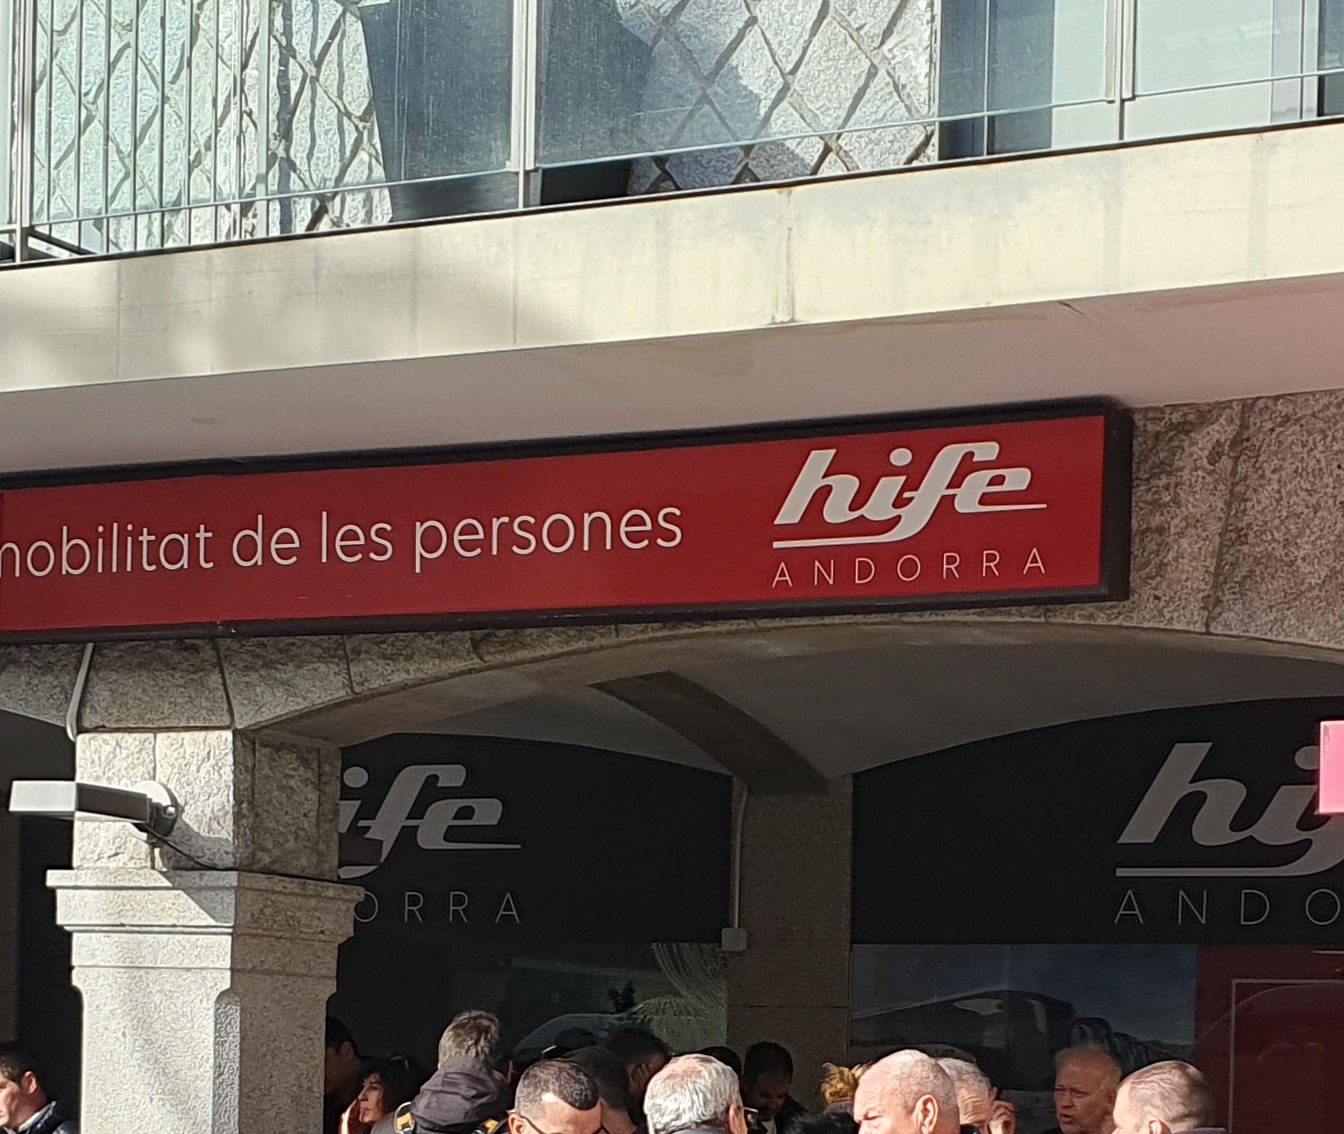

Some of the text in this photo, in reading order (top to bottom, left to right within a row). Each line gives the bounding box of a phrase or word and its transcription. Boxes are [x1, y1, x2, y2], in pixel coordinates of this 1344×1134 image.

[231, 514, 301, 568] de
[320, 511, 394, 563] les
[414, 505, 683, 573] persones
[772, 441, 1048, 549] hife
[772, 547, 1046, 588] ANDORRA
[338, 763, 522, 879] ife
